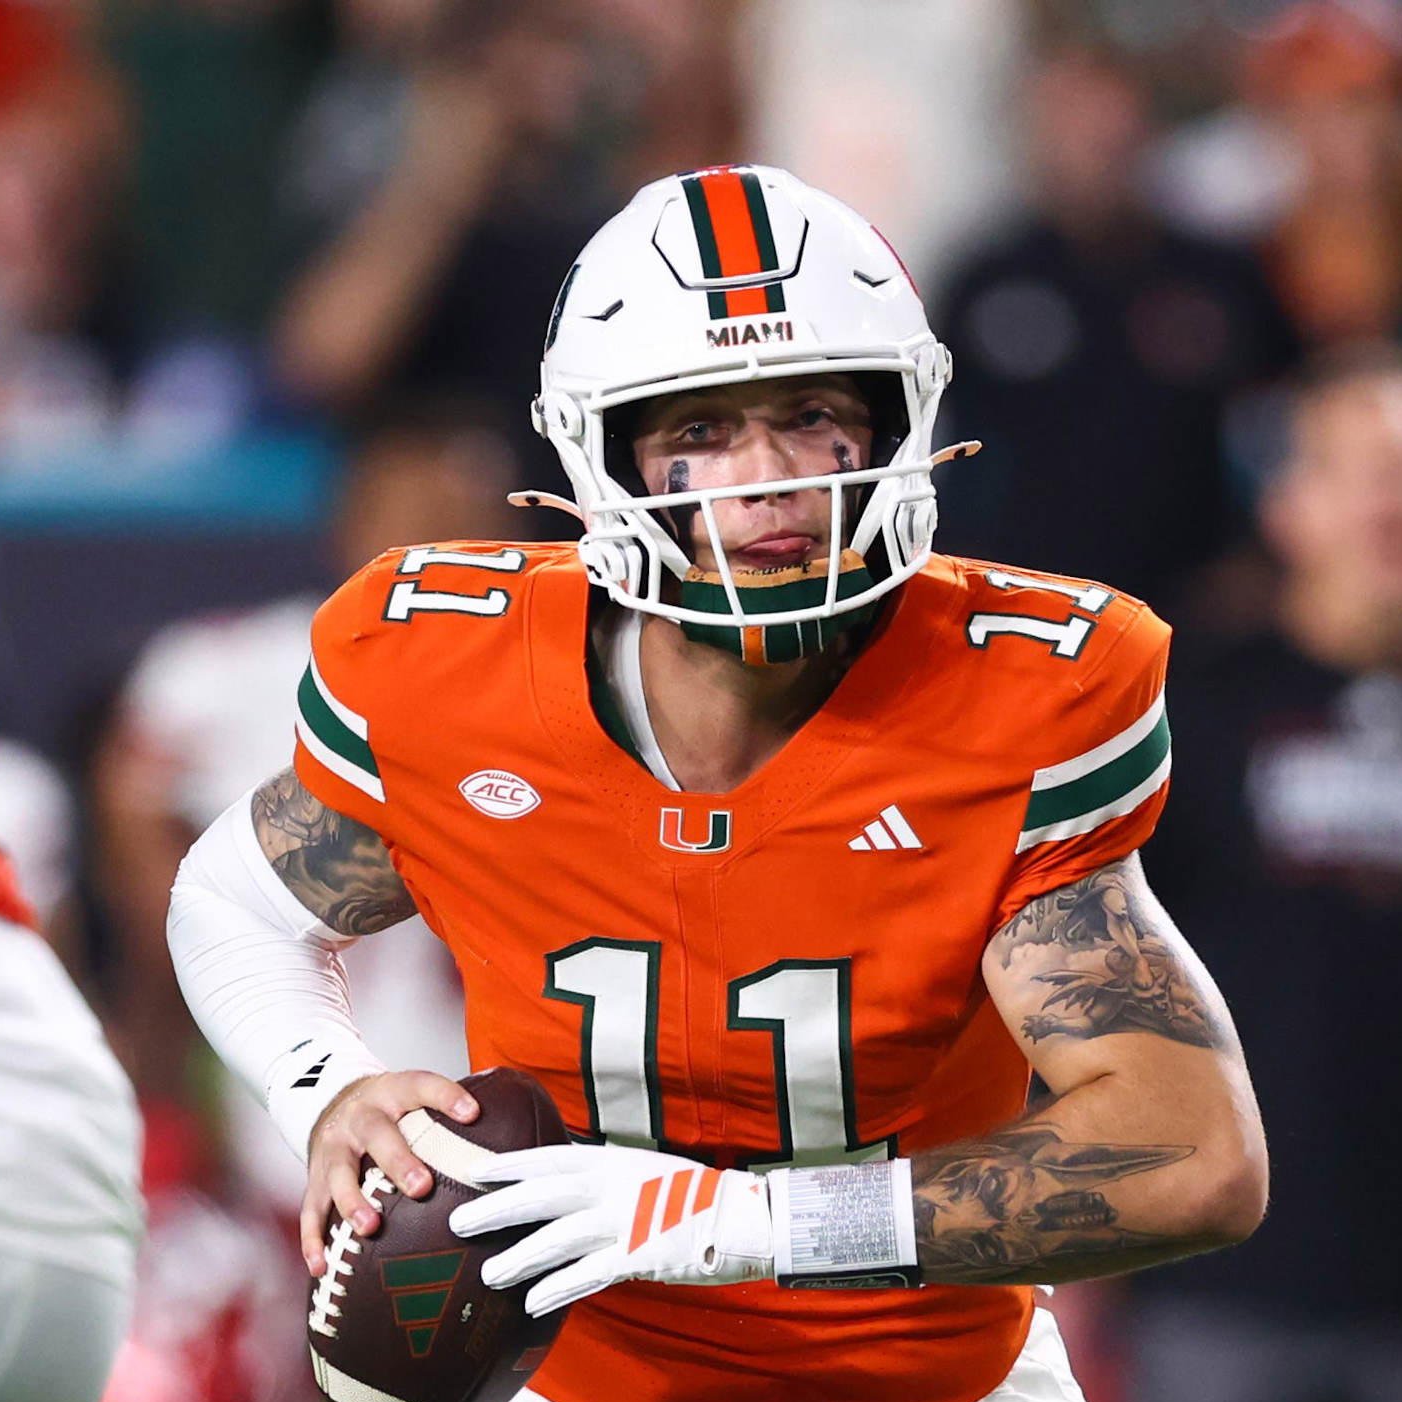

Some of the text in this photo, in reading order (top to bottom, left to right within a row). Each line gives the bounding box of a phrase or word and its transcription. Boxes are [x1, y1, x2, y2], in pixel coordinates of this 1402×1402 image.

[705, 320, 794, 350] MIAMI
[381, 547, 527, 624] 11
[964, 568, 1117, 662] 11
[473, 782, 528, 803] ACC
[659, 807, 732, 853] U
[542, 935, 899, 1177] 11
